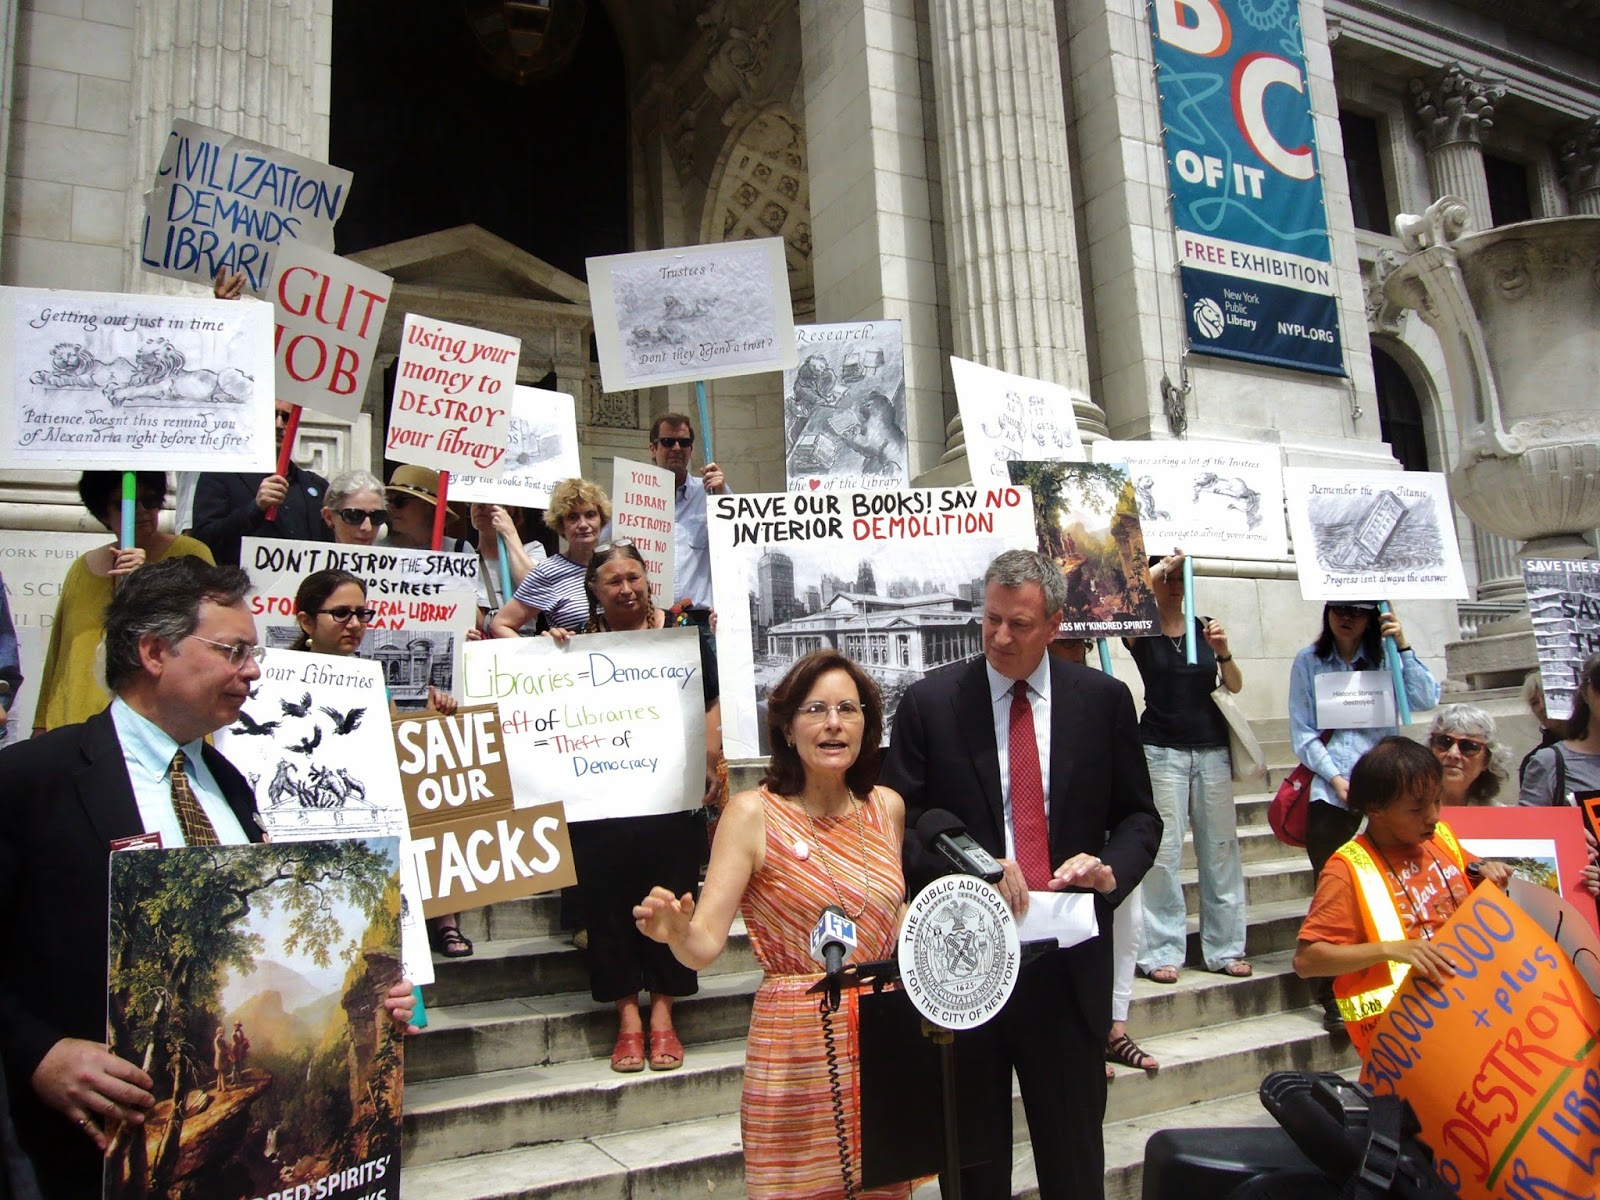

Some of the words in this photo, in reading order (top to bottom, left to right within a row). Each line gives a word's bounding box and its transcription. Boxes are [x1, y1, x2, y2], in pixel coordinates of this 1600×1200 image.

[1175, 149, 1224, 188] OF
[1232, 163, 1266, 199] IT
[167, 183, 302, 246] DEMANDS
[142, 215, 270, 293] LIBRARI
[1184, 239, 1227, 265] FREE
[1230, 250, 1330, 287] EXHIBITION
[277, 265, 388, 340] GUT
[1223, 288, 1242, 301] New
[1242, 291, 1260, 304] York
[1225, 300, 1248, 315] Public
[29, 308, 98, 332] Getting
[103, 315, 129, 328] out
[124, 312, 163, 332] just
[168, 314, 184, 329] in
[189, 317, 225, 332] time
[1226, 313, 1257, 331] Library
[1277, 321, 1335, 344] NYPL.ORG
[406, 324, 466, 363] Using
[462, 340, 518, 366] your
[672, 347, 696, 366] they
[699, 339, 734, 362] defend
[732, 344, 741, 353] a
[401, 359, 474, 395] money
[477, 374, 502, 395] to
[398, 390, 506, 428] DESTROY
[133, 413, 158, 427] this
[163, 412, 215, 429] remind
[203, 420, 236, 434] you
[18, 428, 43, 447] of
[40, 426, 122, 443] Alexandria
[126, 431, 158, 449] right
[160, 430, 197, 449] before
[200, 431, 219, 446] the
[386, 423, 434, 450] your
[436, 426, 506, 469] library
[1189, 456, 1200, 465] lot
[1201, 457, 1214, 469] of
[1214, 456, 1226, 466] the
[460, 474, 477, 486] say
[630, 471, 662, 488] YOUR
[788, 477, 807, 492] the
[823, 477, 839, 490] of
[839, 475, 857, 489] the
[860, 472, 904, 491] Library
[1309, 484, 1358, 496] Remember
[1360, 484, 1374, 496] the
[1396, 486, 1428, 498] Titanic
[624, 492, 668, 512] LIBRARY
[715, 496, 787, 521] SAVE
[793, 494, 841, 516] OUR
[852, 490, 933, 518] BOOKS!
[938, 490, 978, 510] SAY
[985, 488, 1021, 508] NO
[618, 513, 672, 533] DESTROYED
[732, 517, 844, 547] INTERIOR
[852, 512, 994, 541] DEMOLITION
[655, 539, 667, 554] NO
[255, 545, 321, 573] DON'T
[326, 548, 399, 575] DESTROY
[399, 556, 422, 575] THE
[423, 554, 478, 579] STACKS
[1526, 560, 1563, 573] SAVE
[1562, 561, 1590, 573] THE
[379, 578, 446, 596] STREET
[1322, 574, 1359, 588] Progress
[1379, 571, 1406, 586] always
[1406, 571, 1419, 582] the
[1420, 574, 1449, 583] answer
[409, 601, 458, 622] LIBRARY
[1074, 621, 1087, 632] MY
[265, 665, 297, 683] our
[299, 662, 375, 690] Libraries
[463, 651, 575, 700] Libraries
[589, 652, 697, 690] Democracy
[1332, 690, 1357, 698] Historic
[1357, 689, 1384, 697] libraries
[1342, 698, 1376, 707] destroyed
[501, 710, 534, 735] eft
[534, 708, 561, 732] of
[563, 704, 661, 730] Libraries
[397, 711, 501, 775] SAVE
[549, 734, 608, 755] Theft
[611, 730, 632, 749] of
[572, 756, 660, 778] Democracy
[417, 768, 495, 810] OUR
[411, 815, 562, 900] TACKS
[904, 914, 919, 943] THE
[915, 880, 955, 913] PUBLIC
[958, 880, 1011, 926] ADVOCATE
[906, 968, 923, 997] FOR
[921, 995, 941, 1017] THE
[941, 1011, 966, 1023] CITY
[968, 1009, 983, 1021] OF
[984, 988, 1005, 1013] NEW
[1002, 951, 1016, 986] YORK
[956, 982, 975, 992] 1625
[1494, 945, 1559, 1015] plus
[1364, 896, 1515, 1098] 300,000,000
[1442, 978, 1600, 1184] DESTROY
[316, 1154, 392, 1200] SPIRITS'
